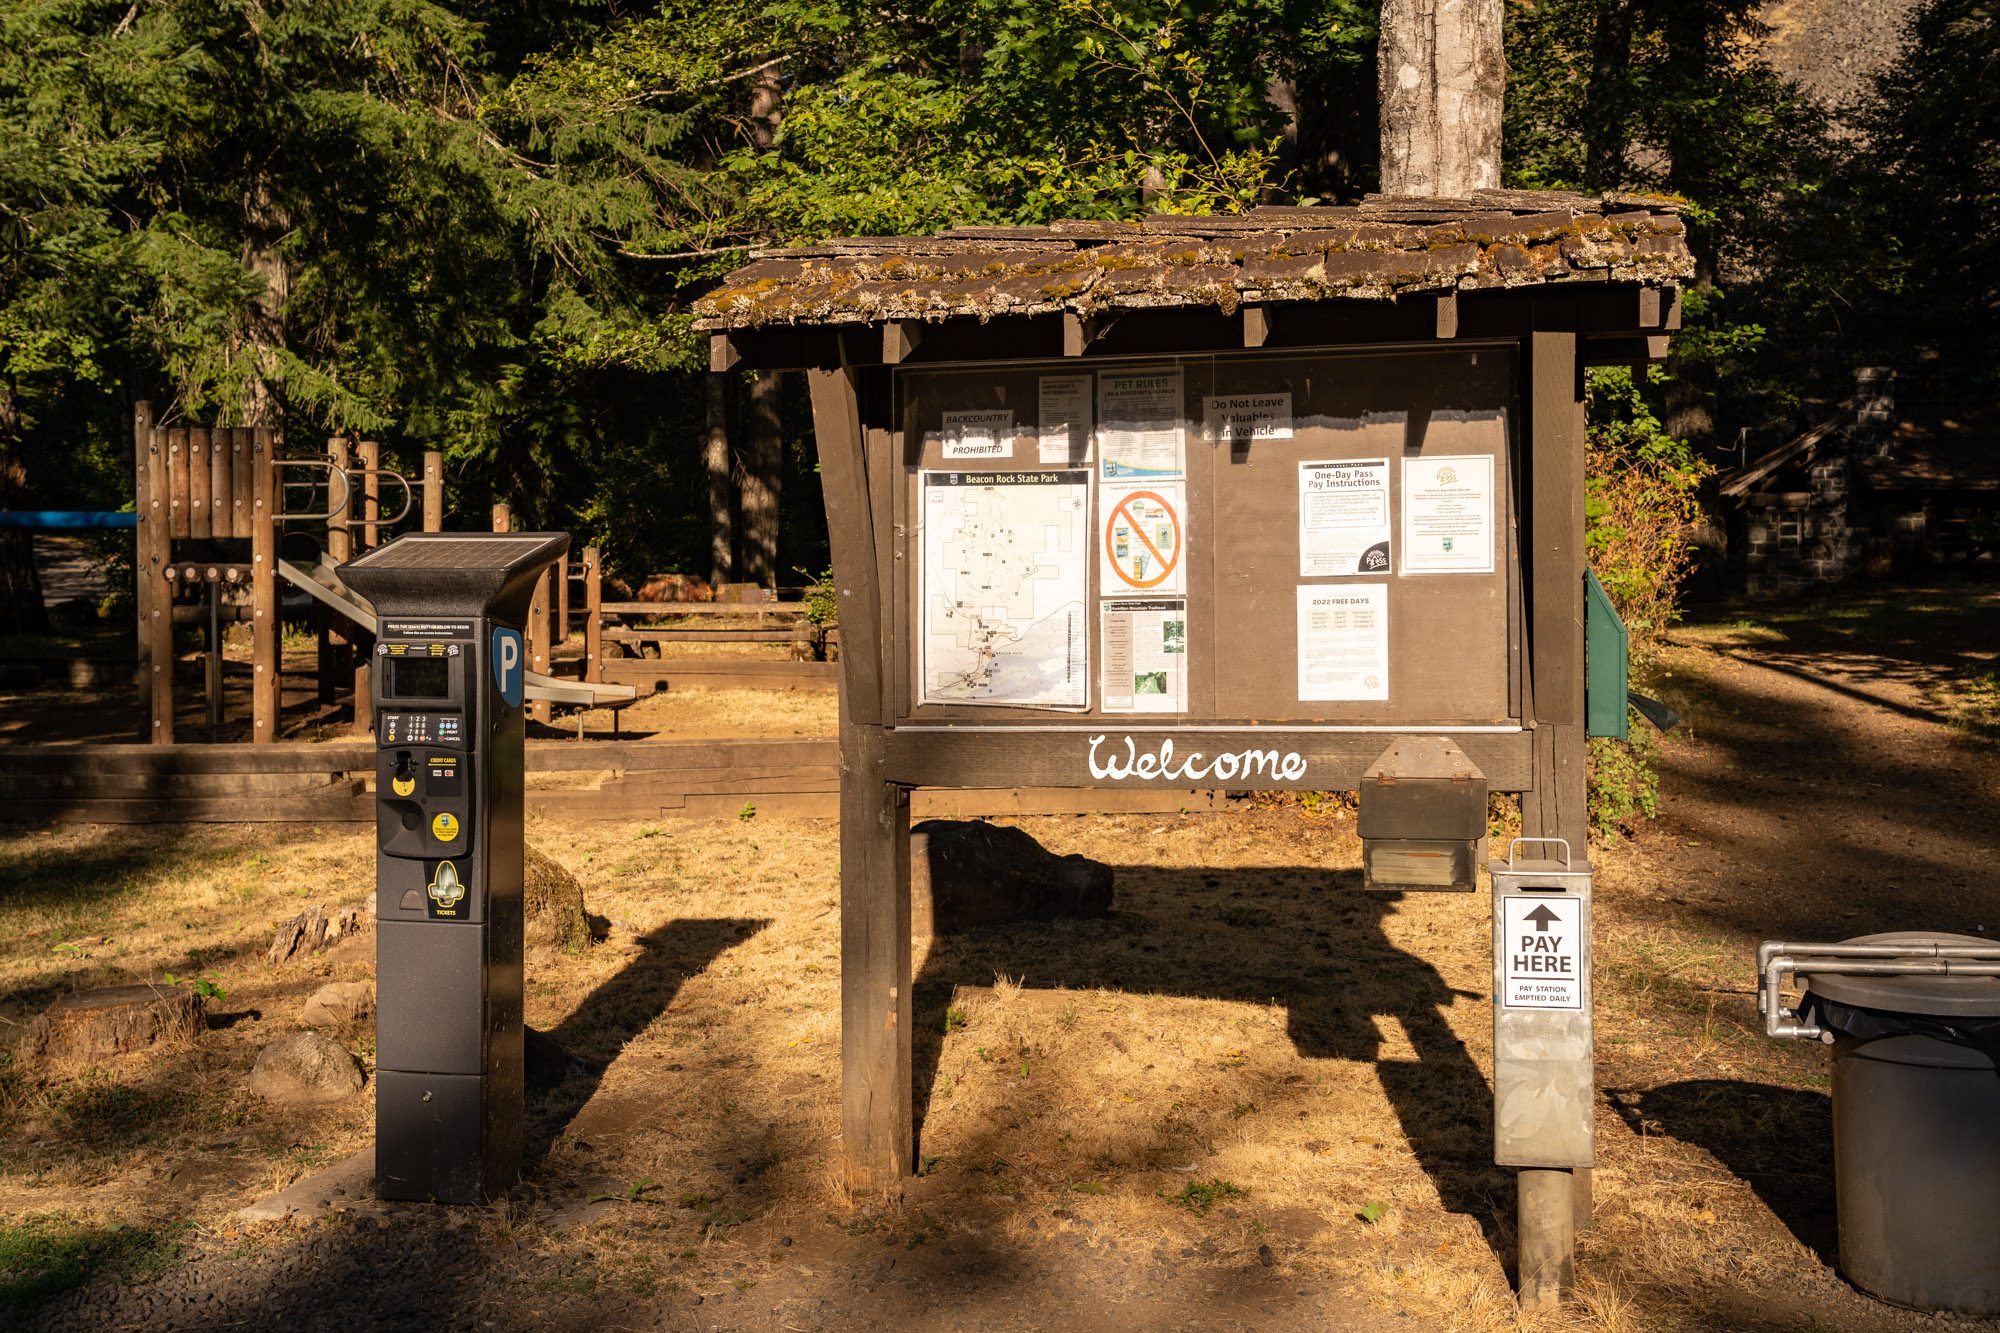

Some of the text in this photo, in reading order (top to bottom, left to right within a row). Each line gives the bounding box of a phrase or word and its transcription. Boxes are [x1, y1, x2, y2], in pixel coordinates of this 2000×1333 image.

[1114, 378, 1168, 390] PET RULES
[1212, 398, 1284, 409] Do Not Leave
[946, 414, 1008, 424] BACKCOUNTRY
[1222, 412, 1274, 422] Valuables
[958, 429, 998, 439] CANG
[1222, 426, 1274, 437] in Vehicle
[952, 446, 1002, 454] PROHIBITED
[966, 474, 1058, 484] Beacon Rock State Park
[1315, 470, 1351, 480] One-Day
[1308, 478, 1380, 489] Pay Instructions
[501, 636, 518, 692] P
[1088, 734, 1307, 780] Welcome
[1522, 936, 1562, 952] PAY
[1514, 955, 1571, 972] HERE
